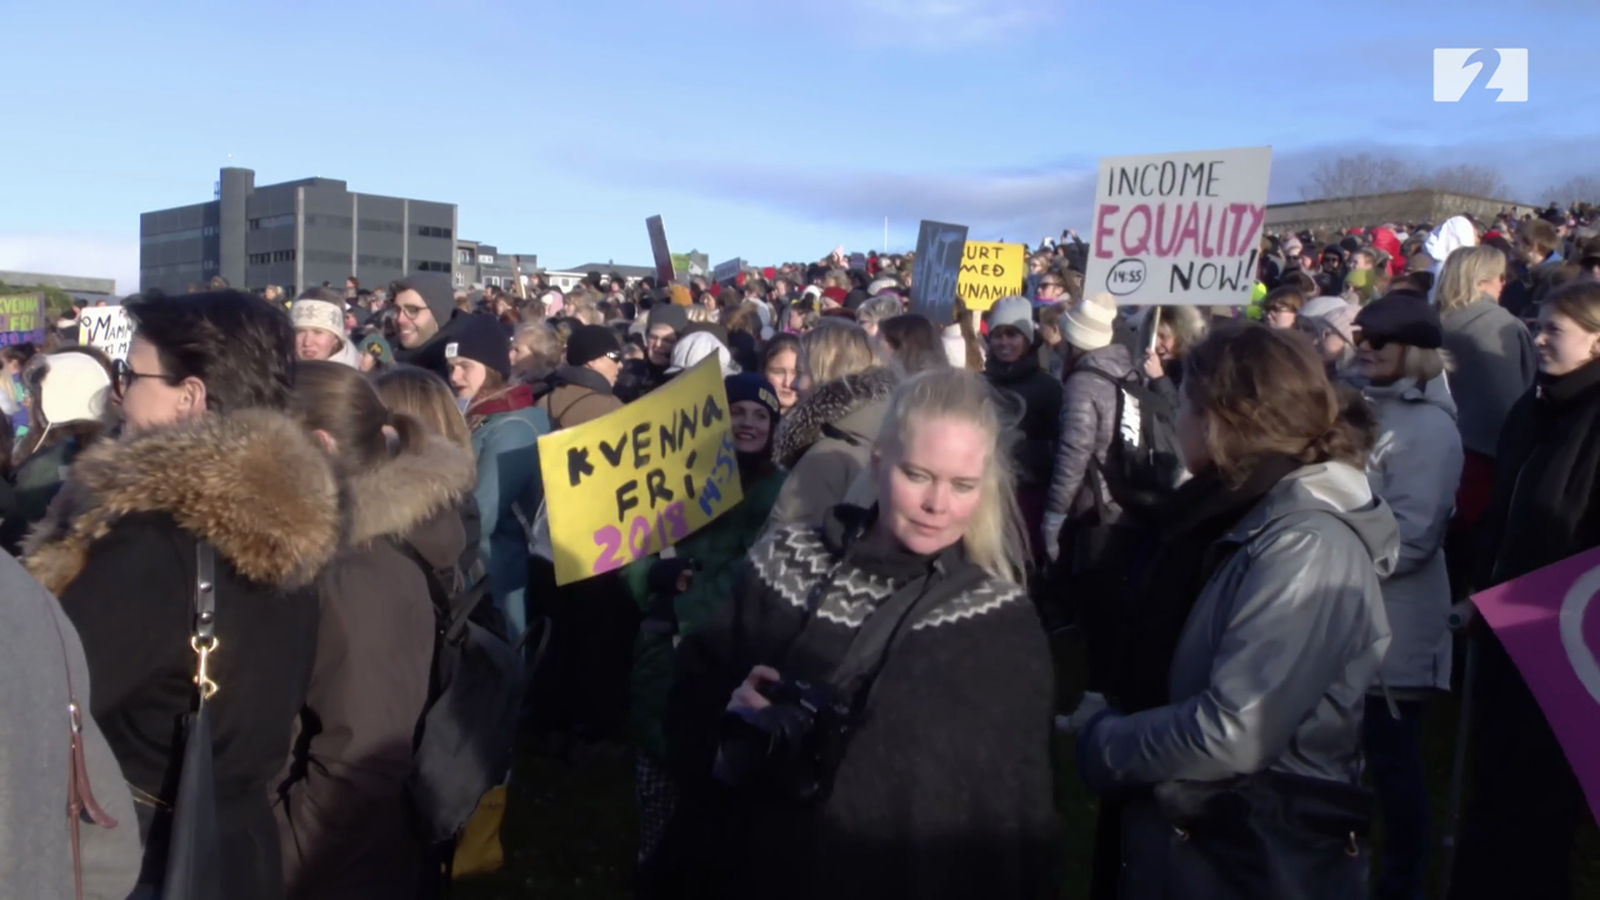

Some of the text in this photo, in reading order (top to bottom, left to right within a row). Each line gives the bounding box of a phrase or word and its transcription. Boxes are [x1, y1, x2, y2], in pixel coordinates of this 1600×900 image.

[1108, 160, 1225, 197] INCOME
[1095, 201, 1266, 259] EQUALITY
[962, 246, 1004, 260] URT
[1169, 248, 1257, 293] NOW!
[1113, 269, 1142, 283] 14:55
[567, 394, 723, 487] KVENNA
[592, 499, 689, 574] 2018
